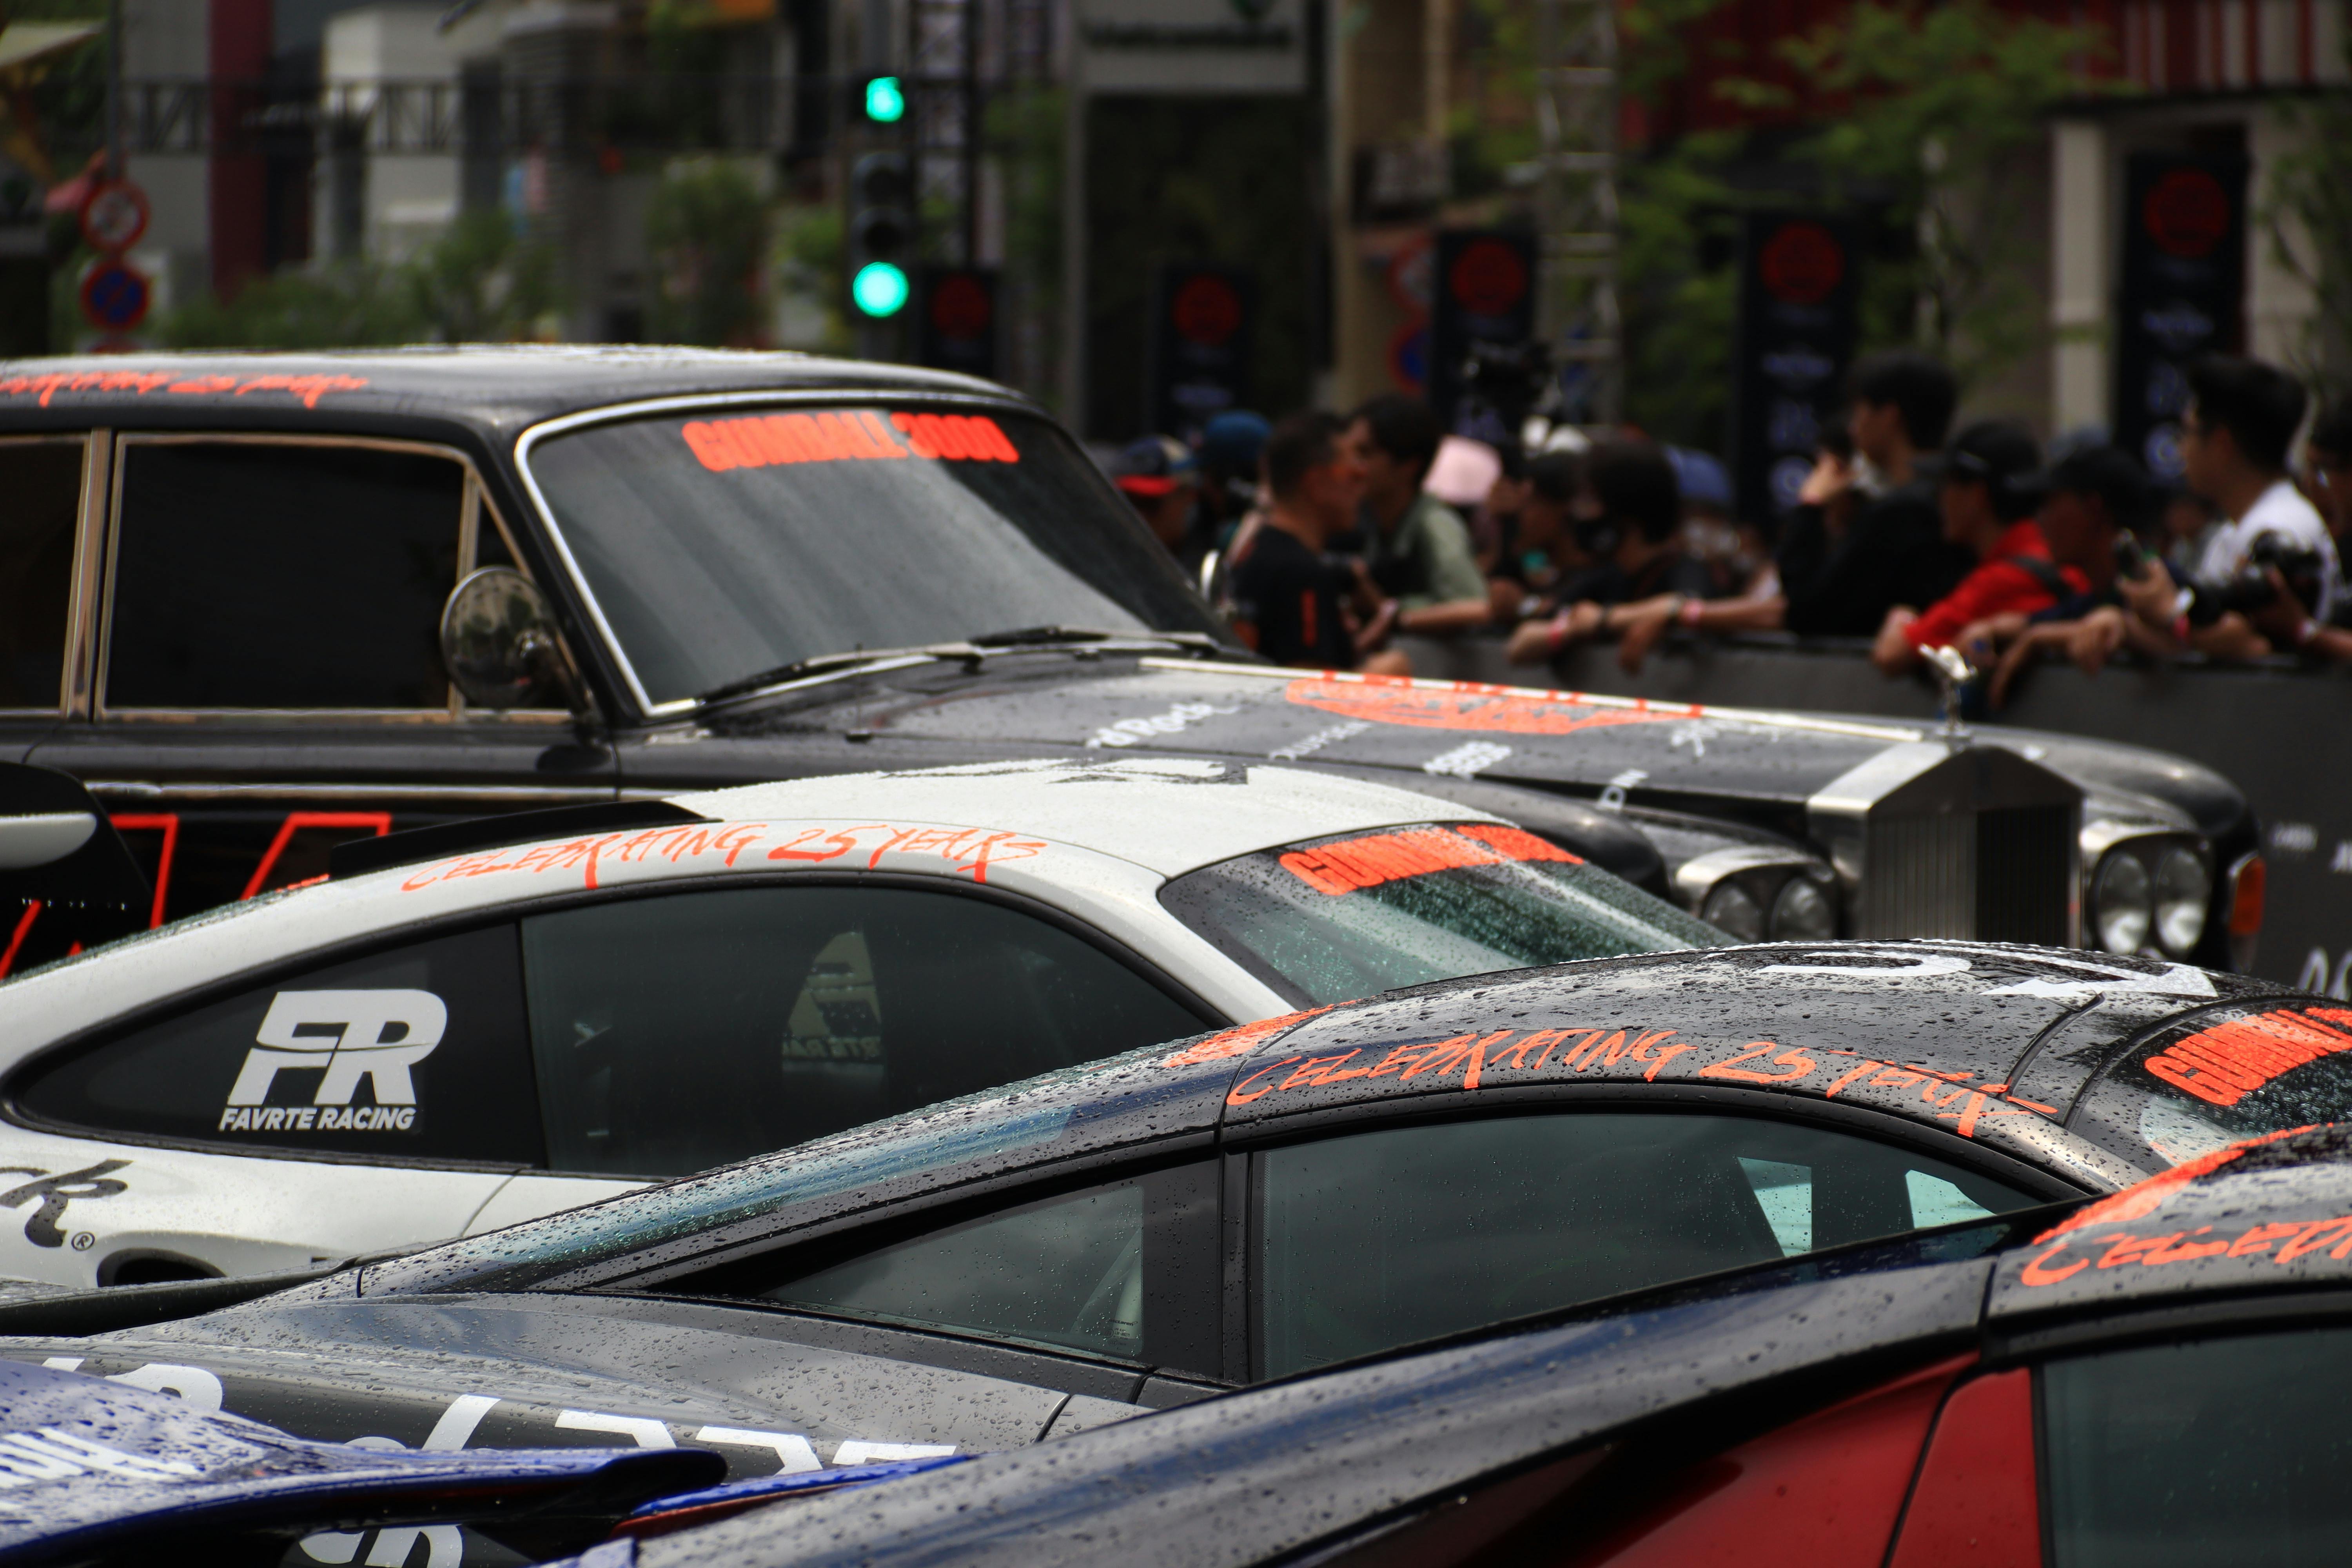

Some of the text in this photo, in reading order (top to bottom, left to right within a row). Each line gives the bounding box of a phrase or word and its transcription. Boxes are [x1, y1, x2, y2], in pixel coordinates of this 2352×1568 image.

[890, 411, 1020, 463] 3000
[401, 821, 1048, 890] CELEBRATING 25 YEARS
[227, 989, 447, 1106] FR
[1226, 1028, 1699, 1105] CELEBRATING
[1699, 1041, 1816, 1083] 25
[218, 1107, 417, 1131] FAVRTE RACING
